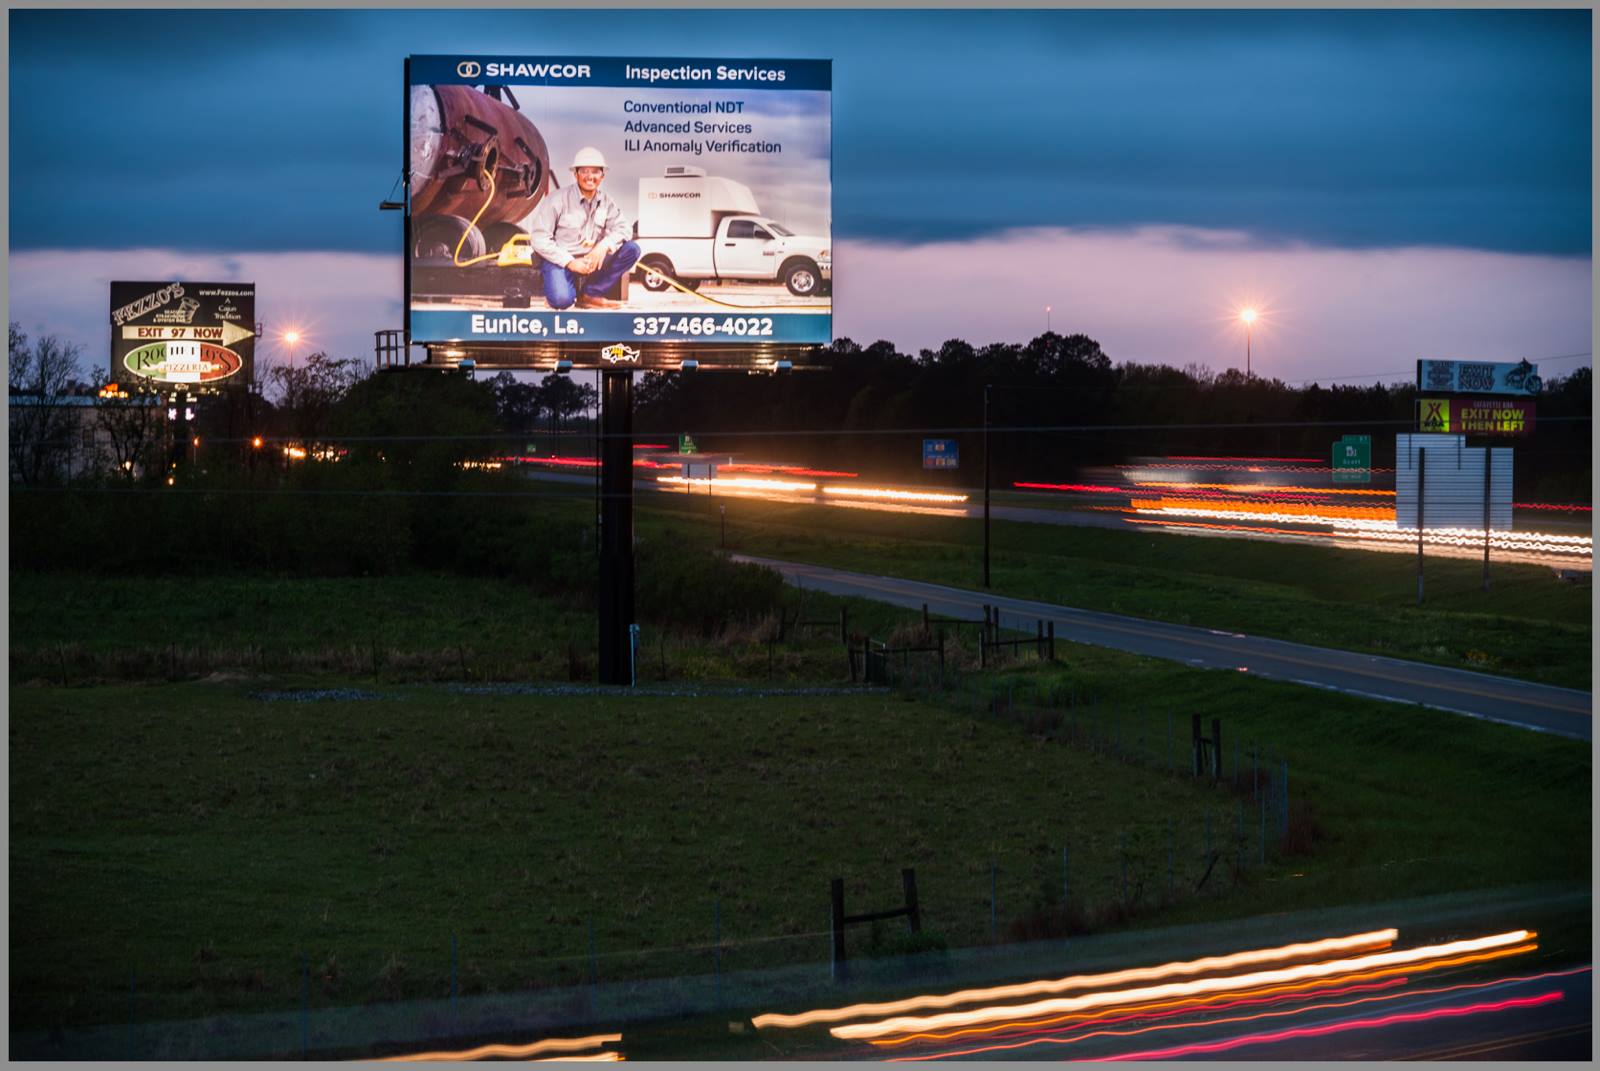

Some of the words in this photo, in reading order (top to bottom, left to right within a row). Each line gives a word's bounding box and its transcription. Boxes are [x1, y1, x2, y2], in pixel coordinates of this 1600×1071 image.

[486, 63, 591, 78] SHAWCOR
[626, 65, 712, 83] Inspection
[716, 66, 786, 81] Services
[624, 100, 712, 114] Conventional
[715, 101, 745, 114] NDT
[624, 120, 691, 134] Advanced
[694, 120, 752, 134] Services
[624, 139, 640, 152] ILI
[643, 140, 702, 155] Anomaly
[705, 140, 782, 154] Verification
[138, 327, 164, 338] EXIT
[171, 328, 186, 338] 97
[193, 328, 223, 338] NOW
[471, 314, 548, 337] Eunice,
[554, 315, 585, 334] La.
[633, 317, 773, 336] 337-466-4022
[163, 363, 209, 371] PIZZERIA
[1461, 408, 1491, 419] EXIT
[1492, 409, 1525, 420] NOW
[1461, 420, 1494, 431] THEN
[1496, 420, 1525, 432] LEFT
